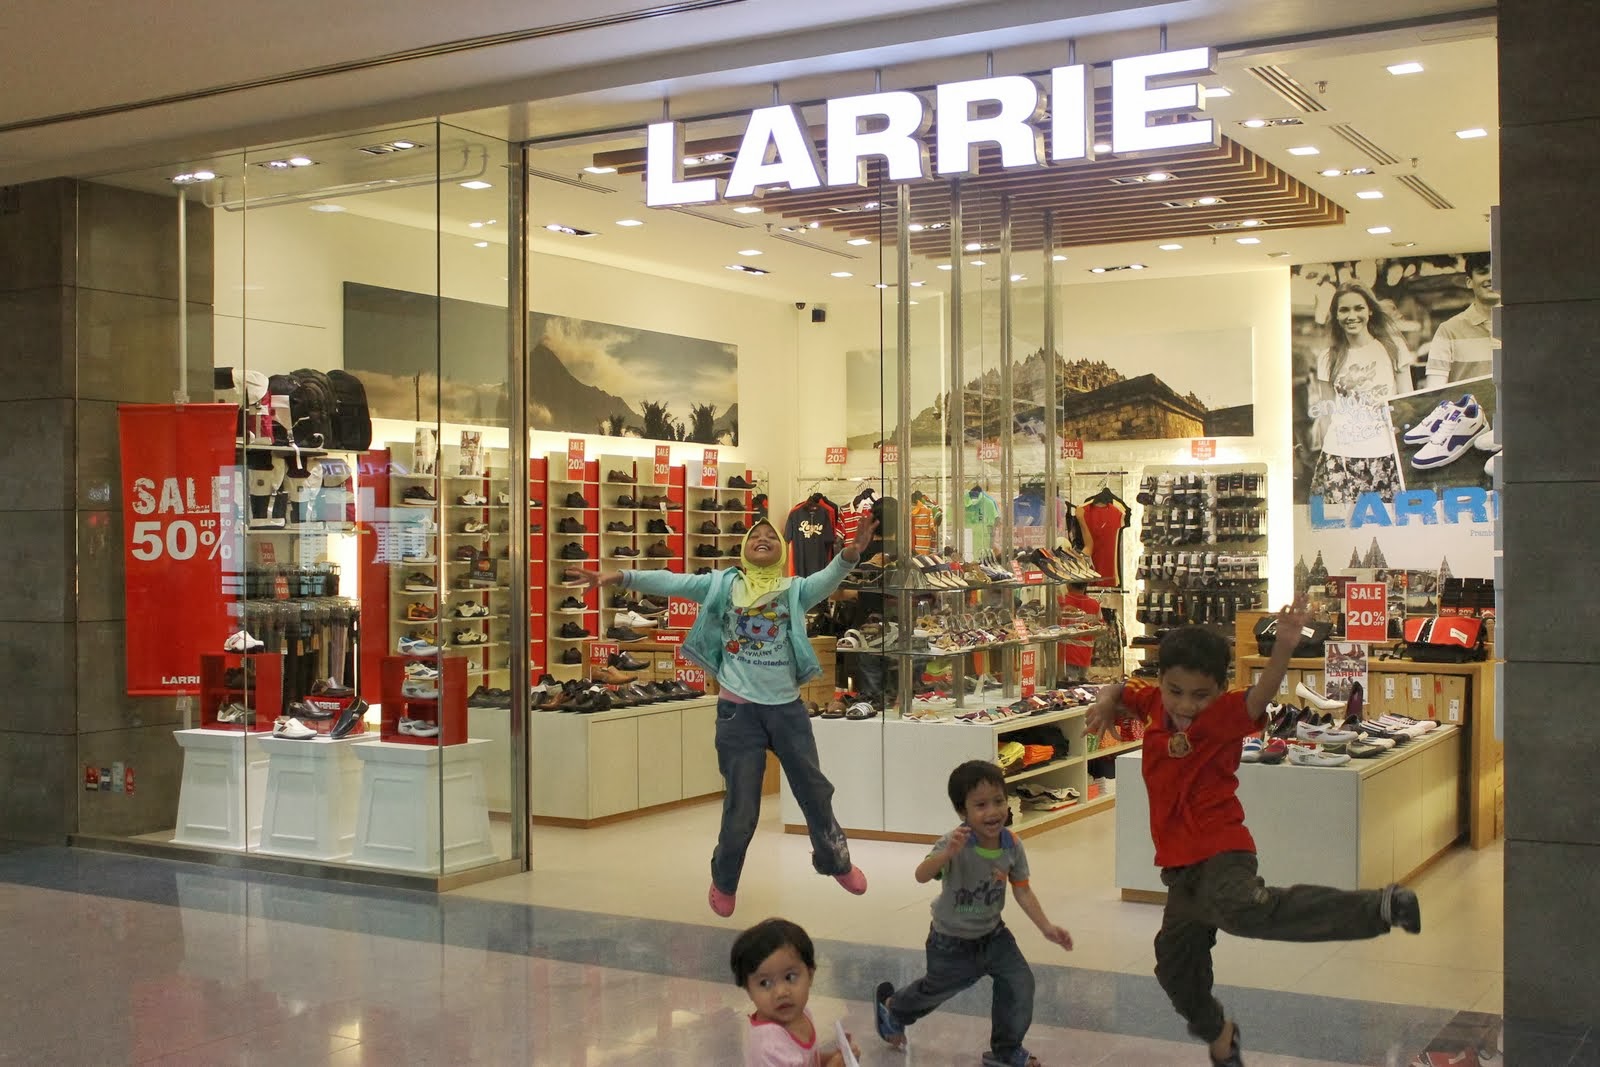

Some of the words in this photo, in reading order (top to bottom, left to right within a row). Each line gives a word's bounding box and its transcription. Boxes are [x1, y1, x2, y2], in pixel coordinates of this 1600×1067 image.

[647, 46, 1217, 207] LARRIE
[570, 441, 584, 451] SALE
[657, 447, 669, 457] SALE
[705, 451, 717, 460] SALE
[568, 458, 584, 470] 20%
[132, 476, 231, 515] SALE
[1309, 486, 1499, 529] LARR
[200, 519, 216, 529] up
[220, 518, 232, 527] to
[131, 520, 232, 561] 50%
[1351, 587, 1382, 600] SALE
[670, 602, 697, 615] 30%
[1348, 610, 1385, 627] 20%
[161, 676, 200, 685] LARRI
[314, 701, 341, 710] ARRIE
